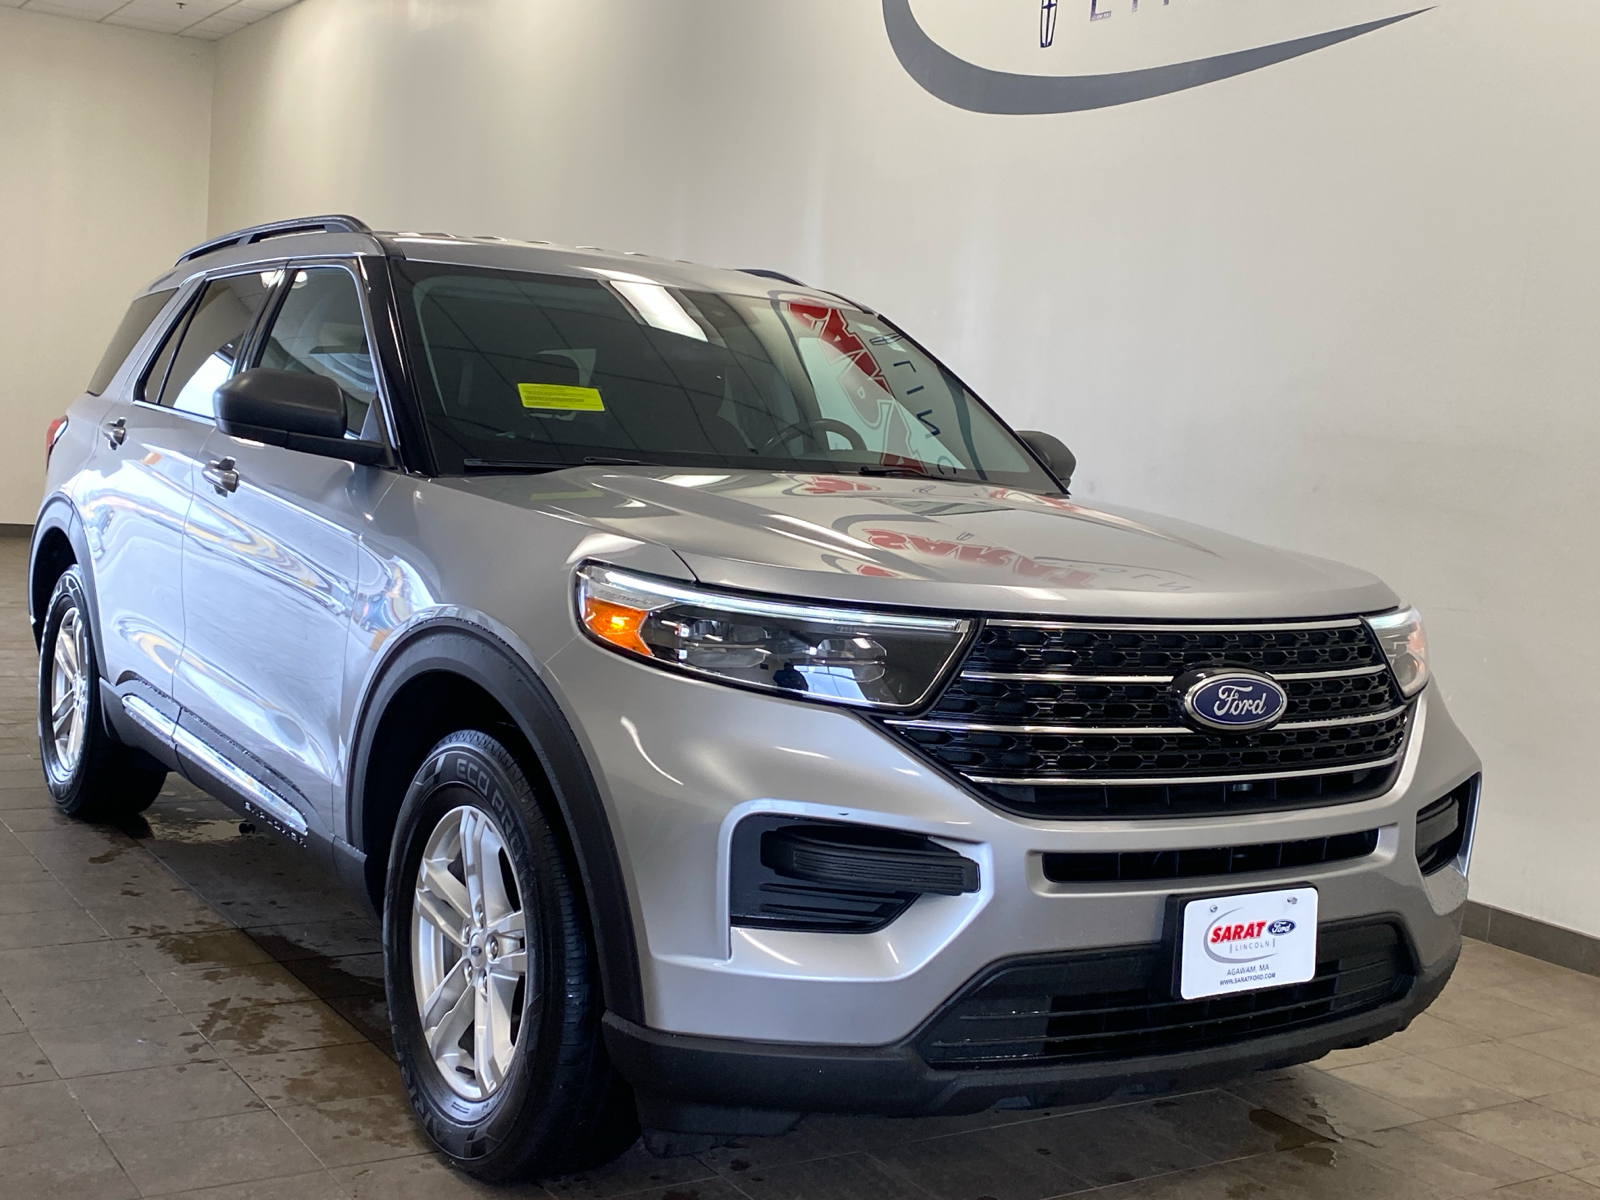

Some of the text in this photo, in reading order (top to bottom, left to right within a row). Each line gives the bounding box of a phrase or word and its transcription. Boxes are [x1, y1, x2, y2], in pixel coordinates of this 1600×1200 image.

[1213, 685, 1267, 716] Ford
[456, 758, 490, 796] ECO
[1210, 920, 1267, 944] SARAT
[1235, 941, 1269, 951] LINCOLN
[1259, 964, 1270, 972] MA
